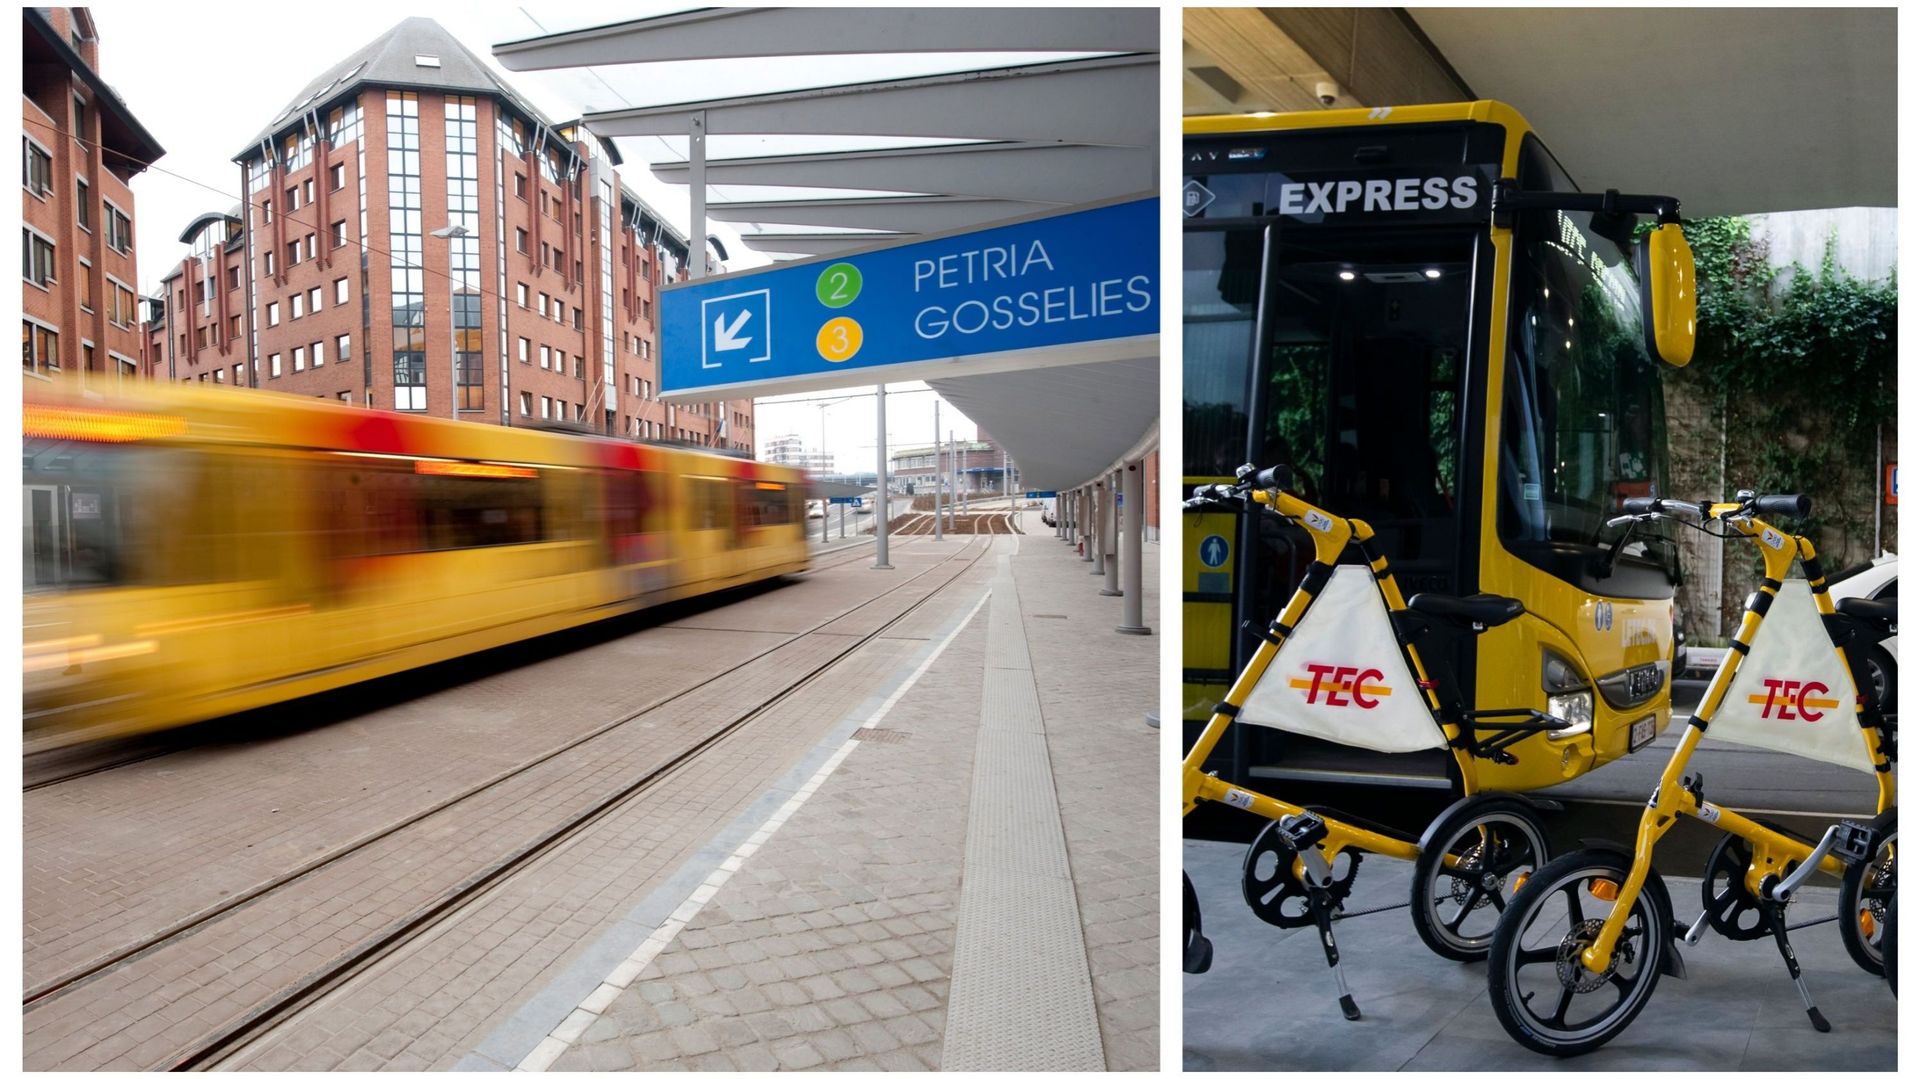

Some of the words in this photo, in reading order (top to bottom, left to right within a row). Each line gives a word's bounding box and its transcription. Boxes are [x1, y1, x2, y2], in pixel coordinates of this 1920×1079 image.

[1279, 176, 1478, 215] EXPRESS
[829, 272, 849, 301] 2
[915, 239, 1054, 293] PETRIA
[829, 326, 849, 355] 3
[915, 275, 1151, 340] GOSSELIES
[1306, 664, 1385, 709] TEC
[1760, 679, 1830, 722] TEC
